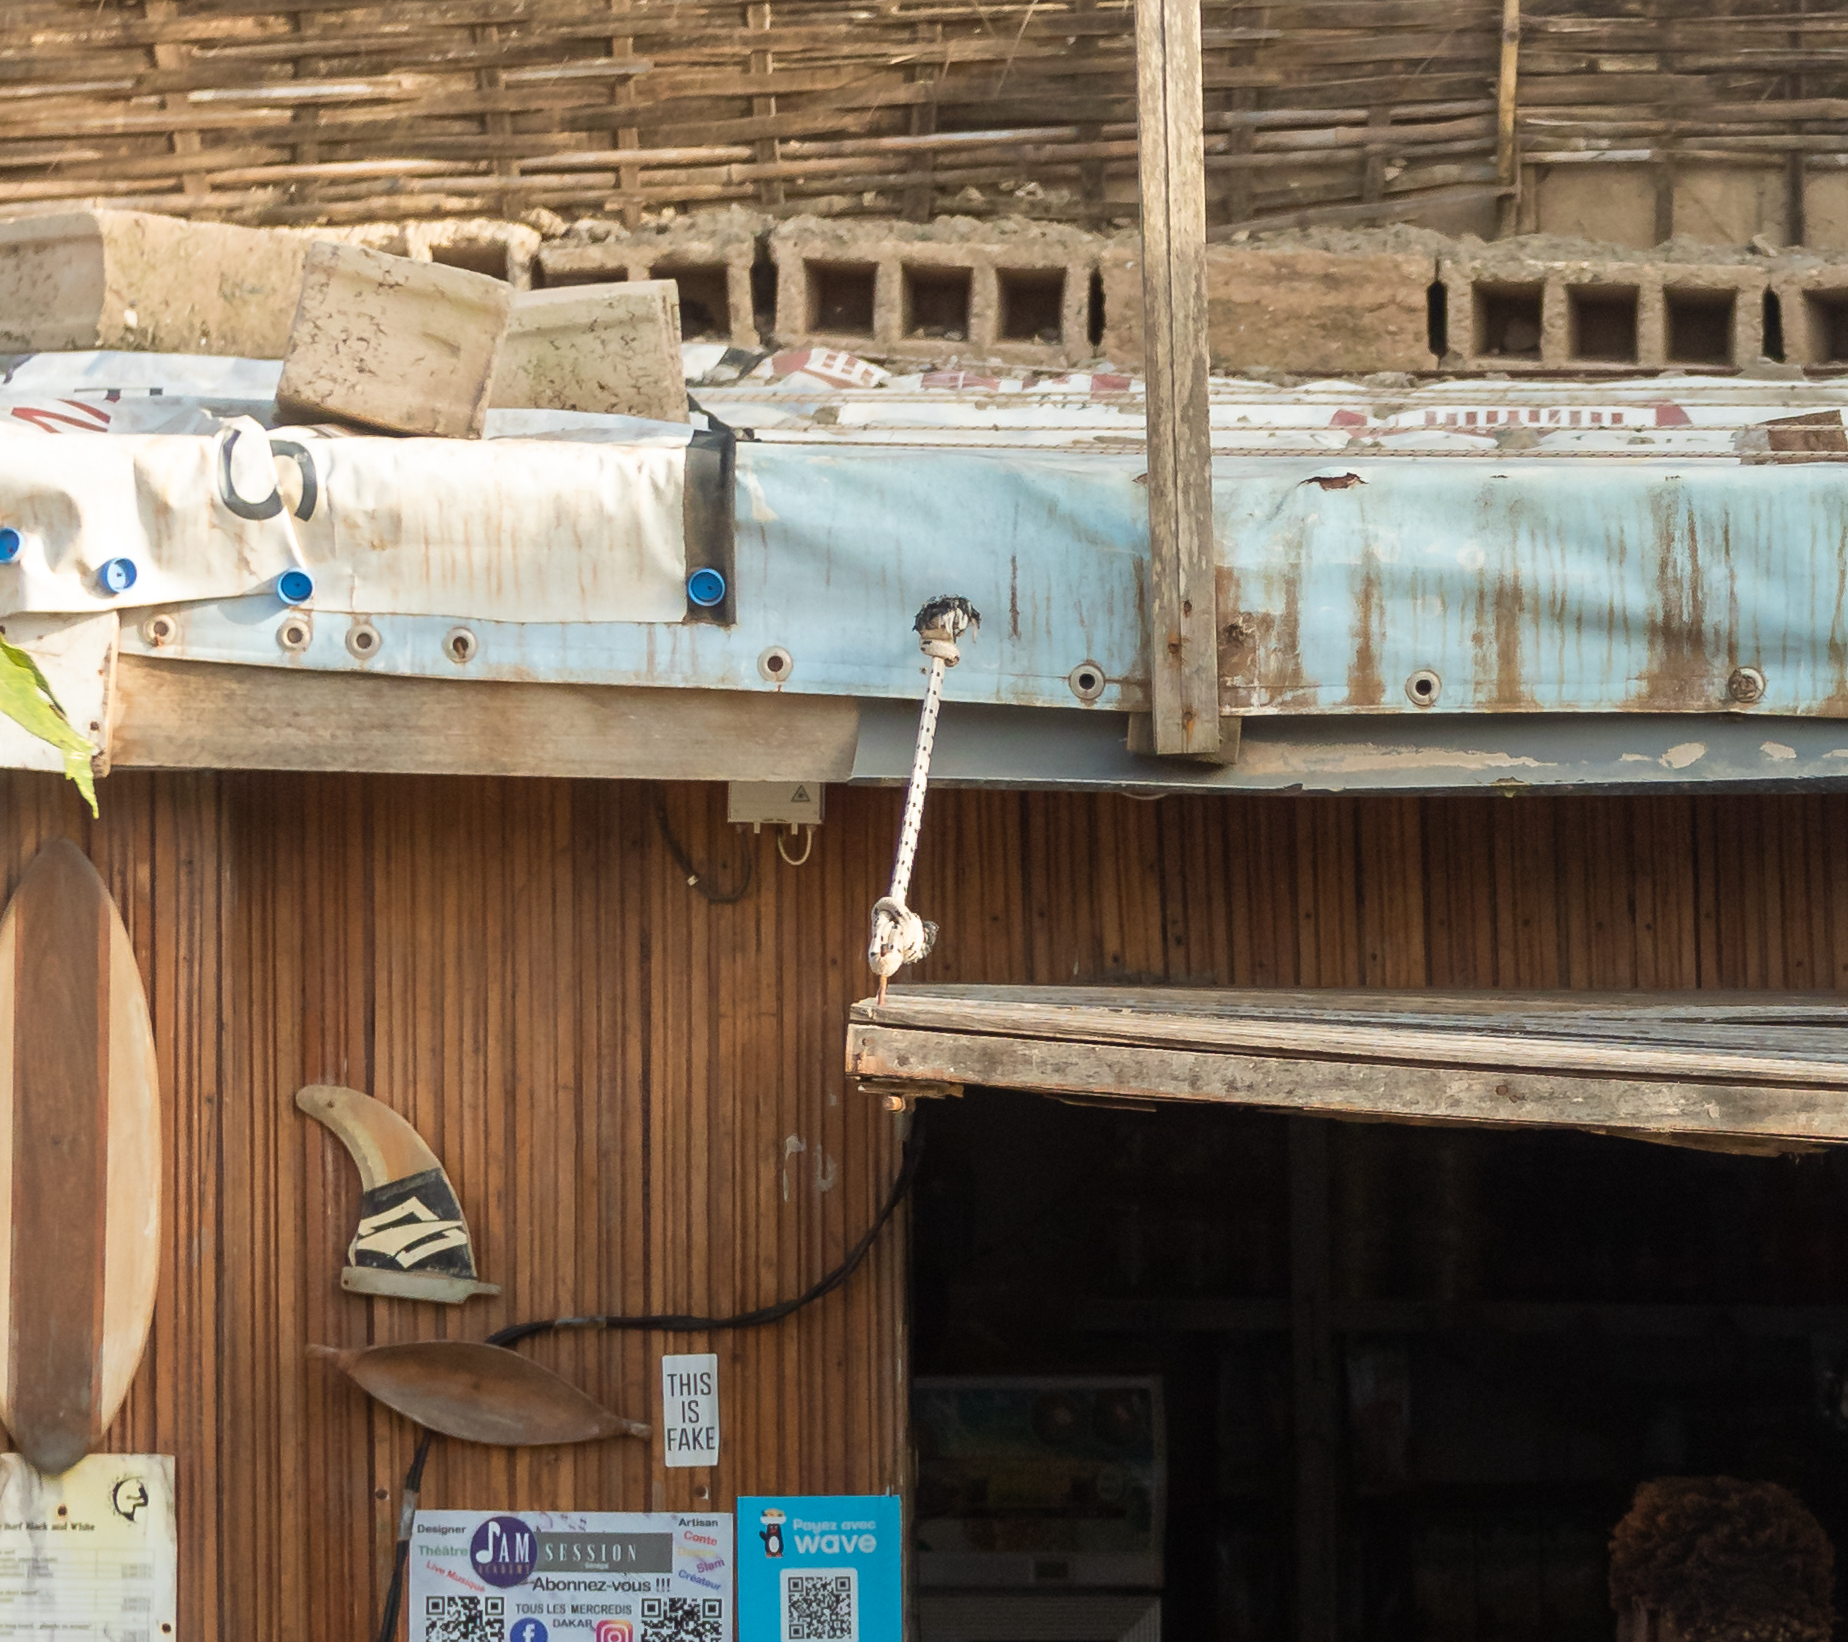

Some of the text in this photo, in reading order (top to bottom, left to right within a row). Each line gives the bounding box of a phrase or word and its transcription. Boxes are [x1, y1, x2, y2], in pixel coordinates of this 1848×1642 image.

[667, 1372, 711, 1397] THIS
[681, 1400, 699, 1424] IS
[667, 1426, 715, 1451] FAKE
[71, 1522, 95, 1531] White
[417, 1524, 467, 1536] Designer
[678, 1518, 719, 1527] Artisan
[792, 1518, 876, 1534] Payez avec
[684, 1530, 718, 1546] Conte
[794, 1534, 877, 1554] wave
[419, 1544, 469, 1557] Théâtre
[545, 1543, 637, 1562] SESSION
[697, 1559, 725, 1573] Slam
[426, 1560, 486, 1593] Live Musique
[532, 1577, 671, 1592] Abonnez-vous !!!
[678, 1569, 722, 1590] Créateur
[515, 1604, 632, 1615] TOUS LES MERCREDIS
[553, 1619, 593, 1628] DAKAR
